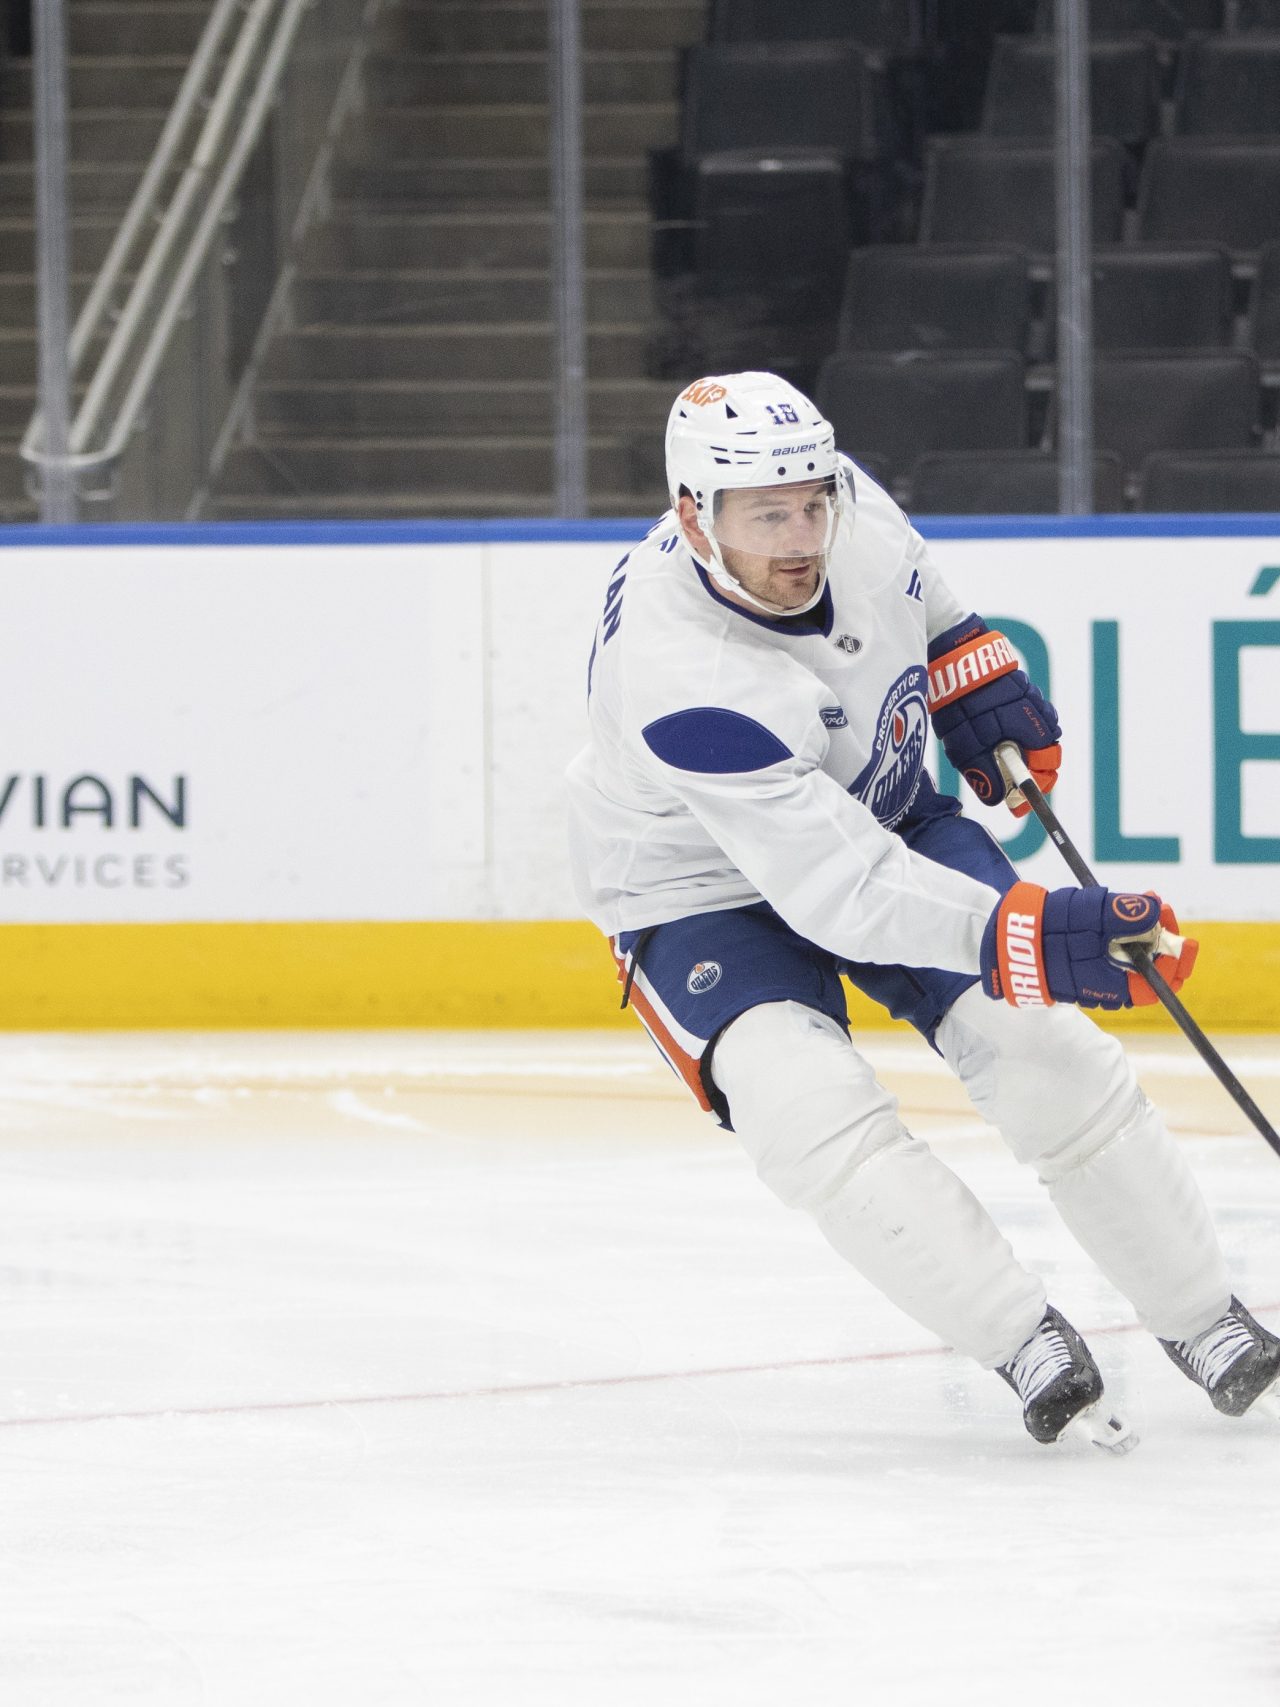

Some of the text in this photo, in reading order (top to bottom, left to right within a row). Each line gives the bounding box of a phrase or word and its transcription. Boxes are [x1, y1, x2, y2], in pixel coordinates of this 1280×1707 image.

[765, 403, 799, 425] 18
[876, 671, 921, 752] PROPERTY OF
